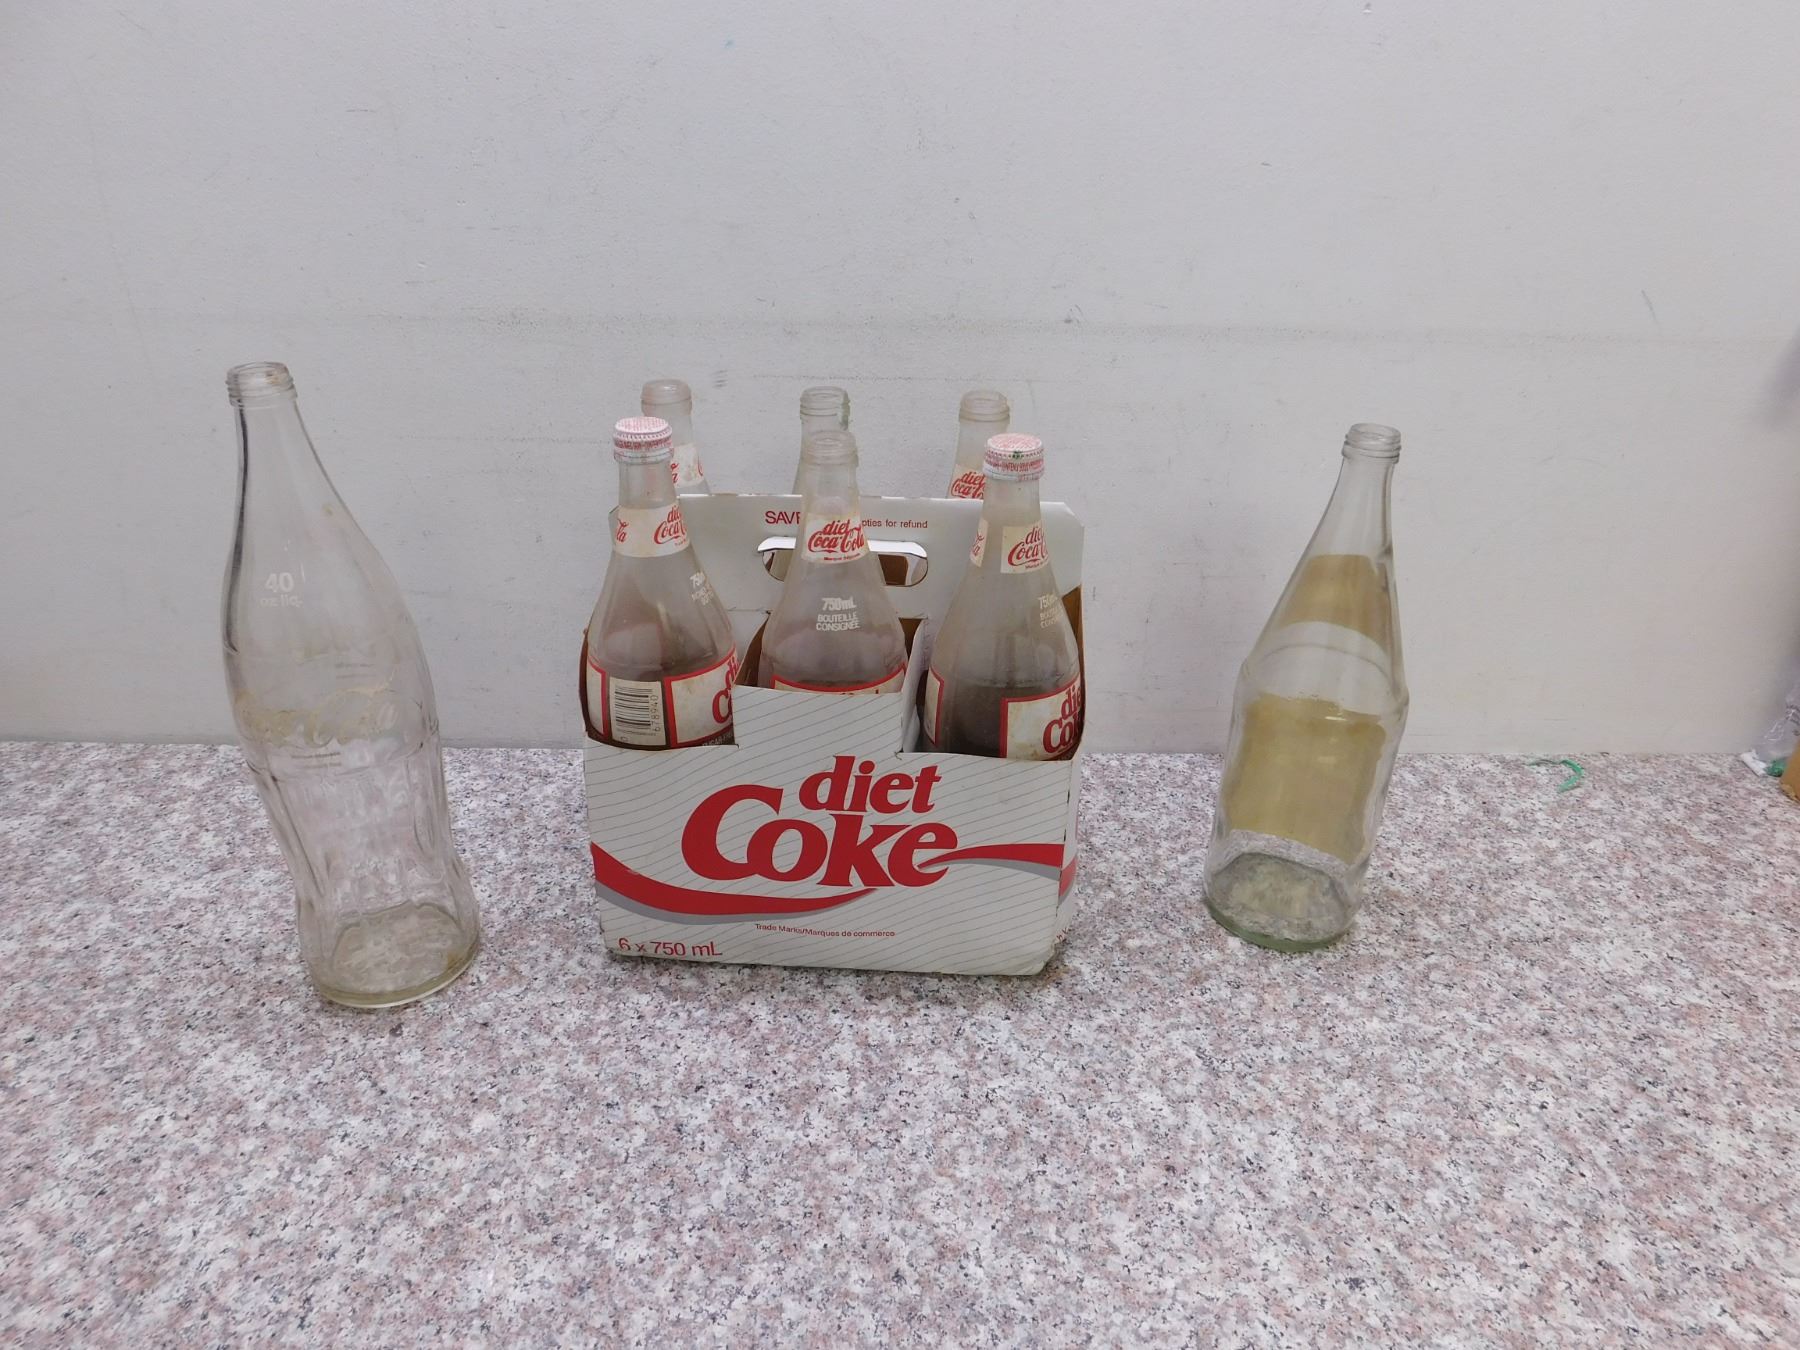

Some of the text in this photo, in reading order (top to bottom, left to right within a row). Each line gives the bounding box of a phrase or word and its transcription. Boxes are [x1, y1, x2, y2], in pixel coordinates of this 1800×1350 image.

[822, 519, 850, 536] diet
[886, 519, 897, 528] for
[901, 520, 928, 529] refund
[808, 525, 865, 553] Coca-Cola
[265, 572, 294, 592] 40
[822, 597, 857, 611] 750mL
[817, 612, 858, 623] BOUTEILLE
[798, 755, 942, 814] diet
[681, 784, 958, 888] Coke
[755, 923, 777, 931] Trade
[618, 937, 722, 957] 6 x 750 mL
